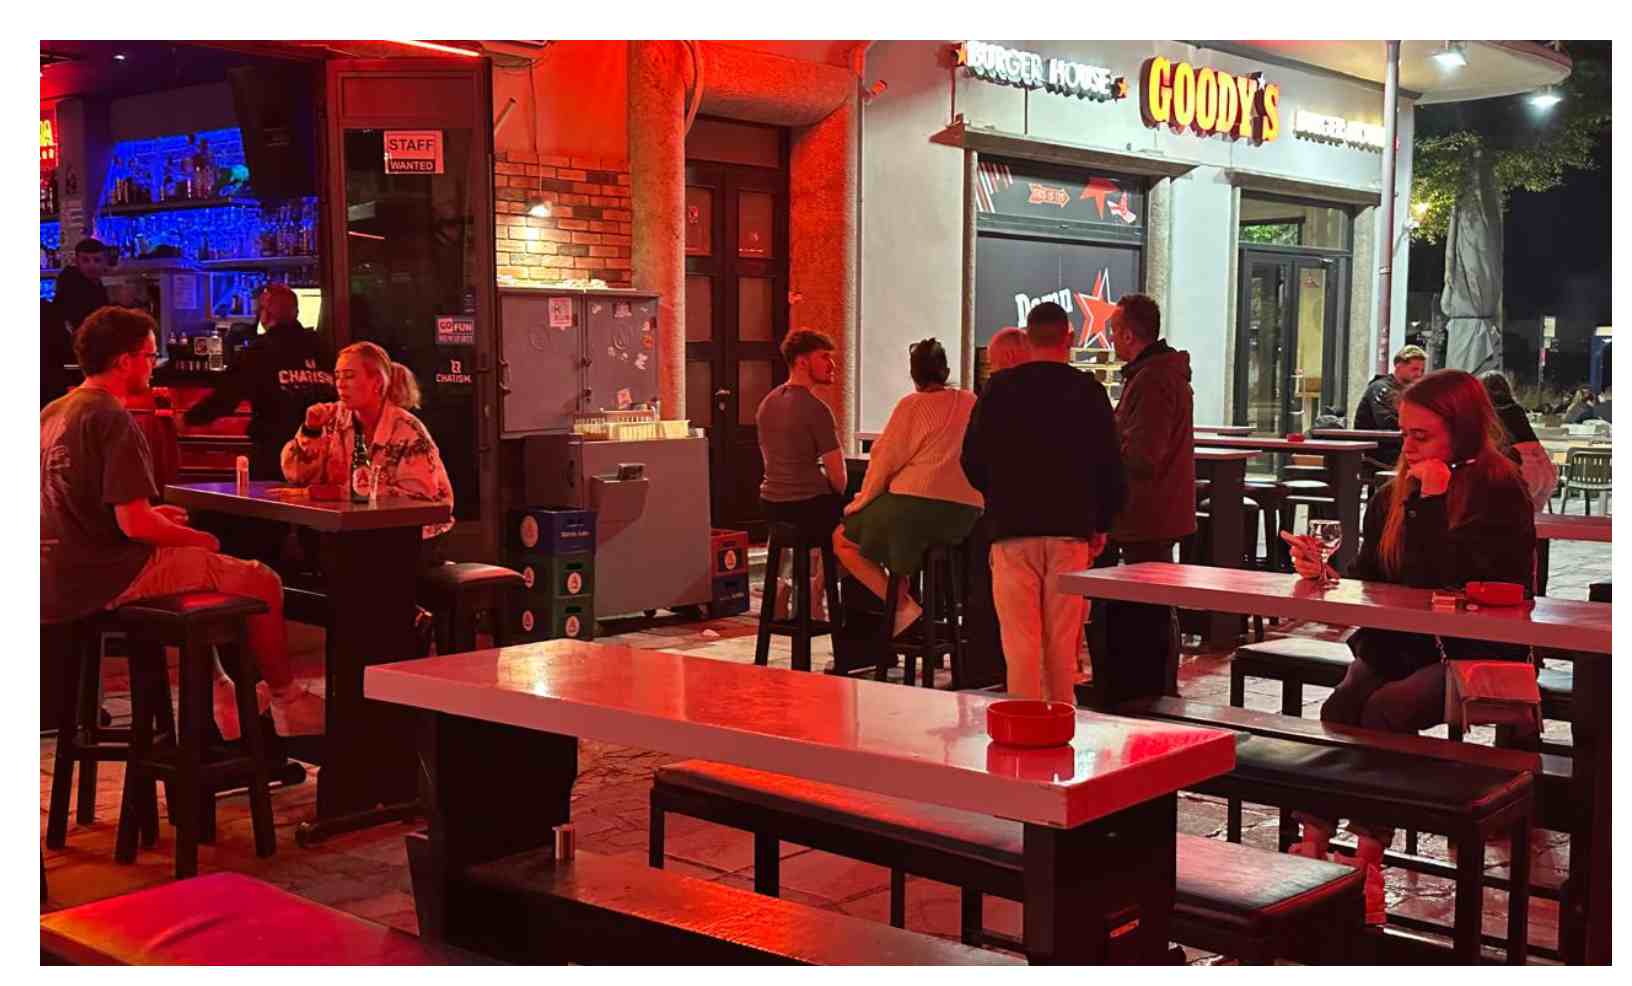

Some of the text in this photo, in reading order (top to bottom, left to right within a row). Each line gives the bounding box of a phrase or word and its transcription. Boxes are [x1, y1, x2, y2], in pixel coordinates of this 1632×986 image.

[965, 40, 1112, 97] BURGER HOUSE
[389, 138, 434, 151] STAFF
[391, 160, 434, 170] WANTED
